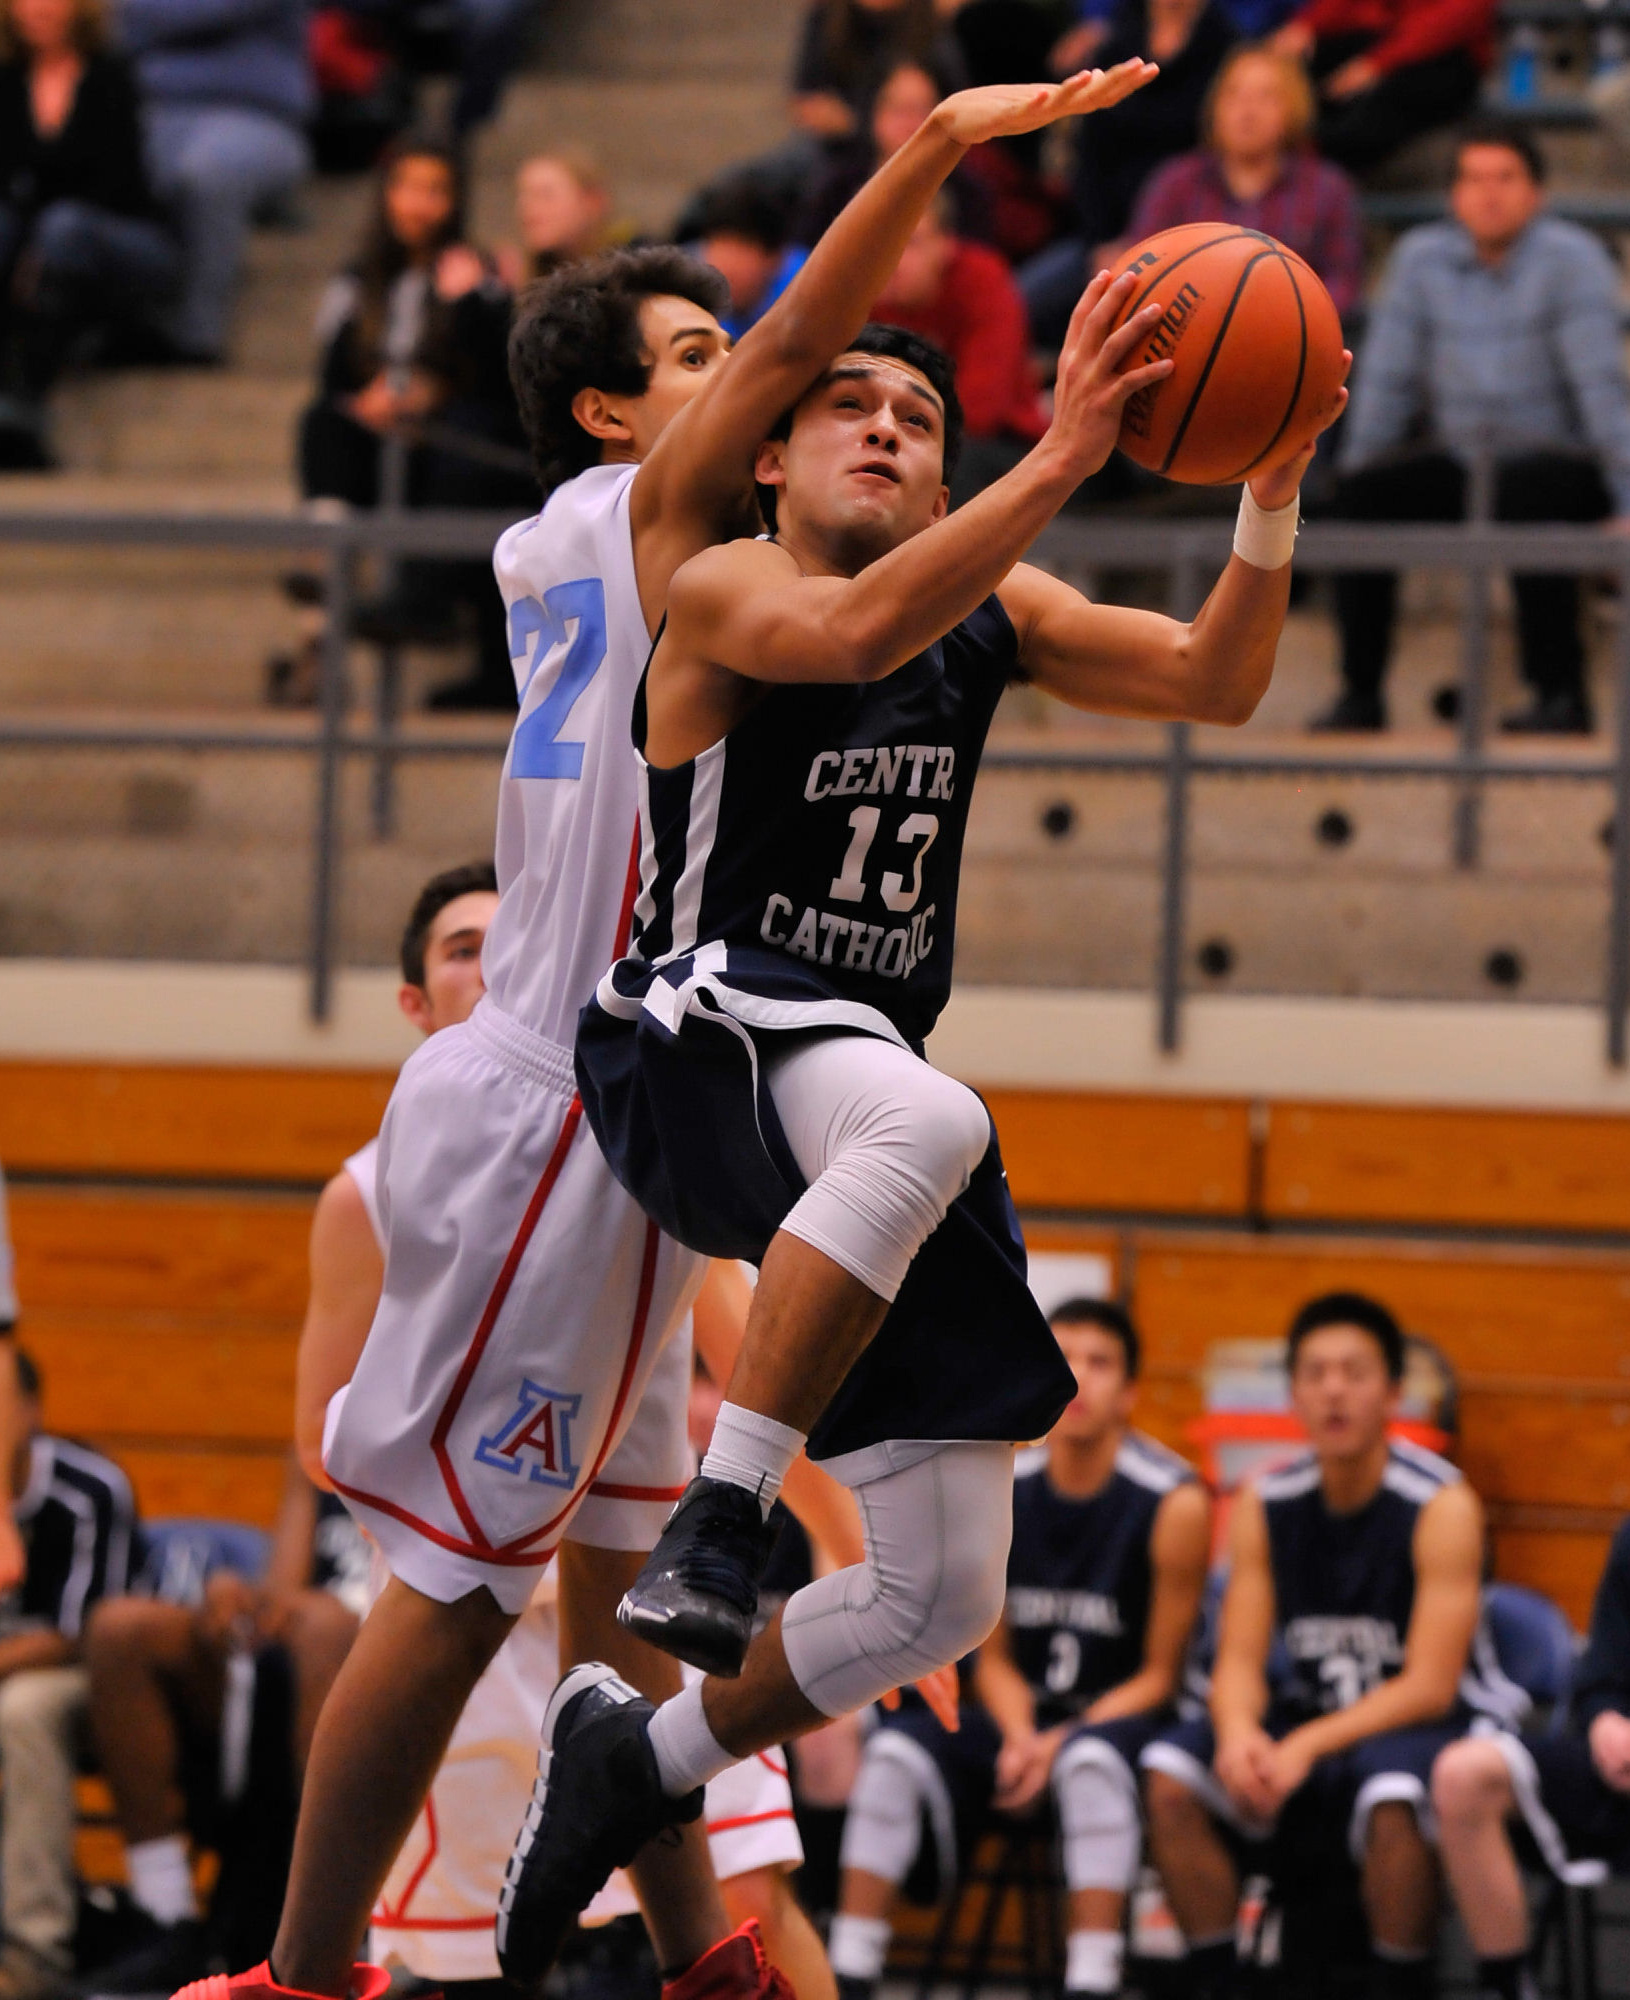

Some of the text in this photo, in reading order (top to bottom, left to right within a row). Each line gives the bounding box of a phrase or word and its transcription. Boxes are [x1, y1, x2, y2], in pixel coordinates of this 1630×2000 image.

[509, 577, 608, 779] 22
[828, 805, 939, 912] 13
[473, 1376, 583, 1491] A
[1045, 1630, 1081, 1692] 3
